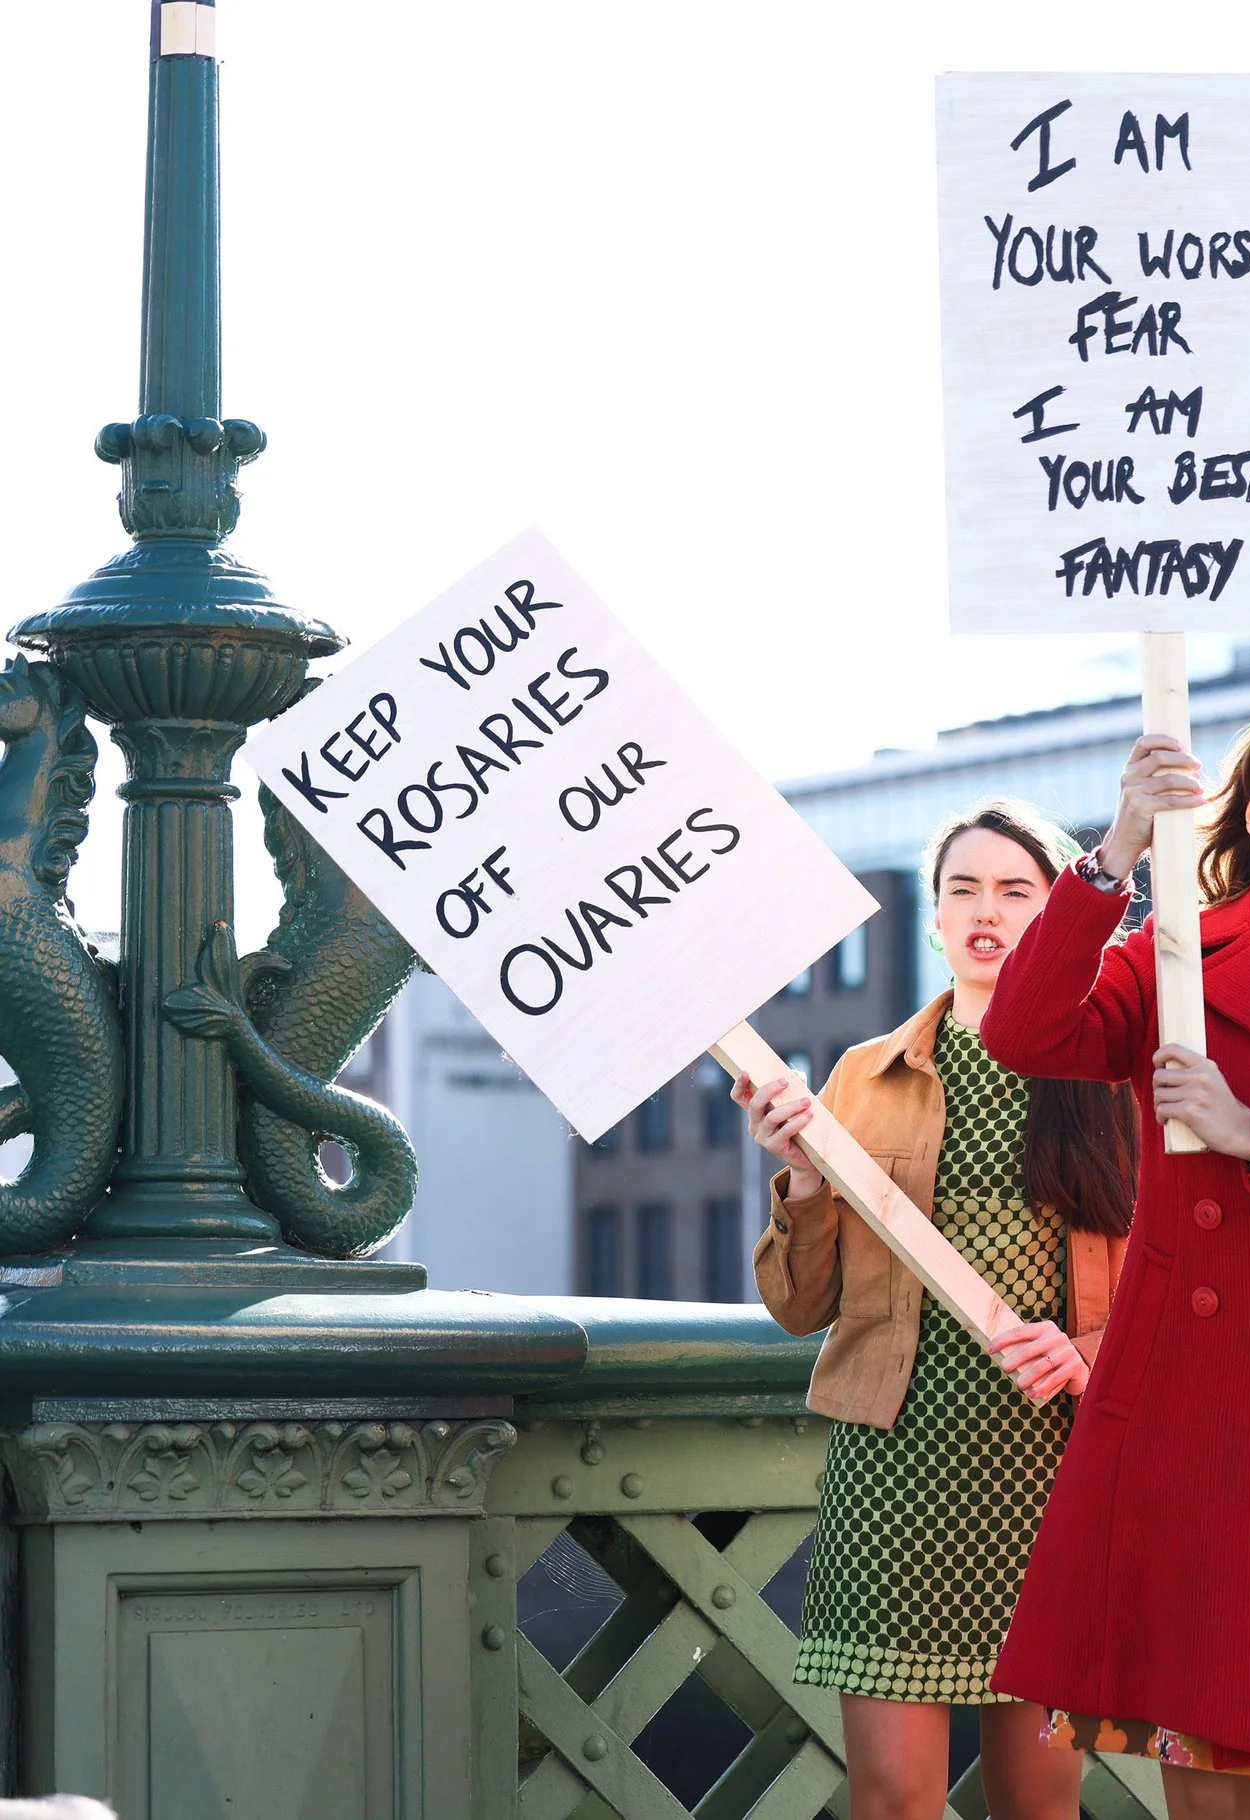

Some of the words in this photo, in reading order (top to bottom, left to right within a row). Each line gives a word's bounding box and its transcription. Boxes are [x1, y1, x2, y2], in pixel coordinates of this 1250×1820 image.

[1010, 99, 1076, 192] I
[1114, 111, 1191, 173] AM
[984, 213, 1112, 290] YOUR
[1069, 291, 1192, 362] FEAR
[1013, 385, 1080, 443] I
[1126, 386, 1202, 437] AM
[1039, 455, 1145, 511] YOUR
[1056, 537, 1244, 601] FANTASY
[282, 693, 401, 813] KEEP
[420, 580, 563, 690] YOUR
[357, 647, 609, 870] ROSARIES
[436, 846, 514, 938] OFF
[559, 742, 667, 831] OUR
[500, 808, 740, 1015] OVARIES
